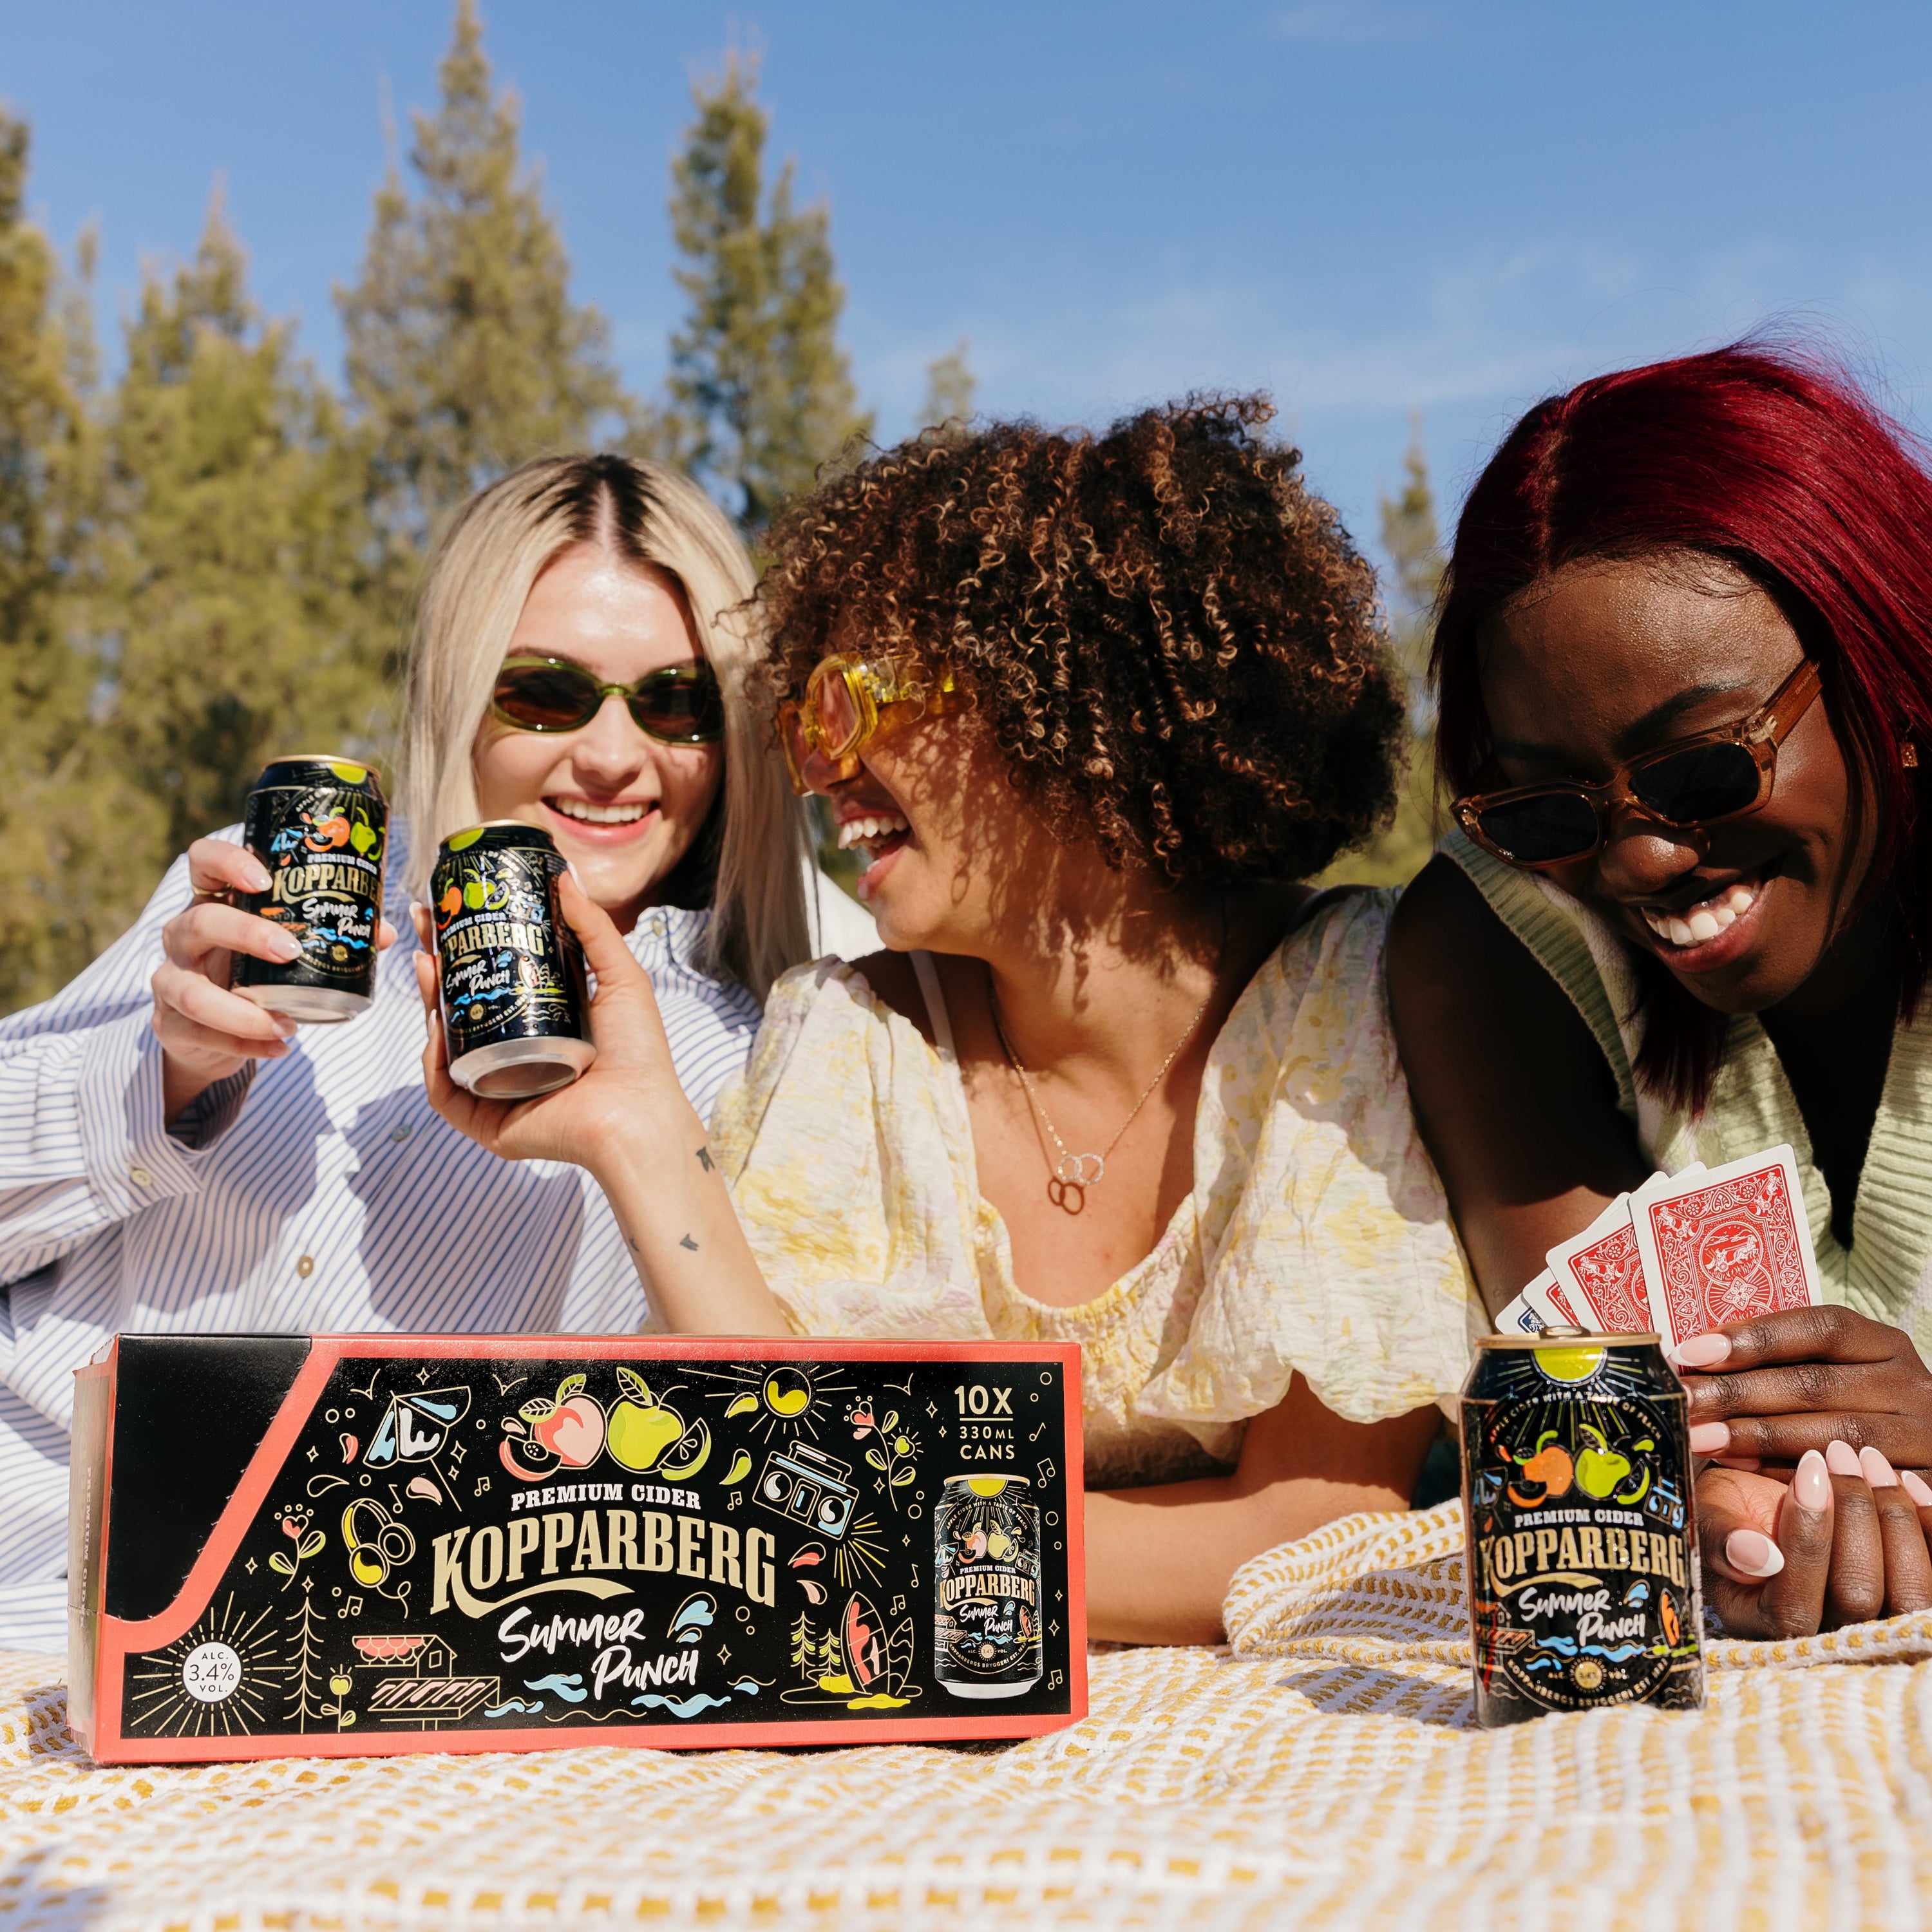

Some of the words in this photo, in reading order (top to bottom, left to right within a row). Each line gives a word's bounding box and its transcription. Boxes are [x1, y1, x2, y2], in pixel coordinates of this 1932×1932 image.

[272, 864, 382, 905] KOPPARBE
[474, 912, 507, 923] CIDER
[954, 1385, 1014, 1415] 10X
[1622, 1401, 1636, 1414] OF
[960, 1444, 1015, 1460] CANS
[511, 1483, 623, 1511] PREMIUM
[630, 1485, 701, 1510] CIDER
[946, 1515, 958, 1530] APPLE
[957, 1504, 972, 1515] CIDER
[993, 1501, 1009, 1510] TASTE
[1016, 1513, 1028, 1530] PEACH
[1514, 1509, 1590, 1528] PREMIUM
[1595, 1509, 1644, 1526] CIDER
[430, 1509, 775, 1618] KOPPARBERG
[960, 1565, 993, 1575] PREMIUM
[995, 1565, 1016, 1574] CIDER
[1479, 1526, 1685, 1596] KOPPARBERG
[940, 1573, 1035, 1610] KOPPARBERG
[949, 1643, 980, 1667] KOPPARBERGS
[981, 1658, 1009, 1668] BRYGGERI
[189, 1663, 234, 1681] 3.4%
